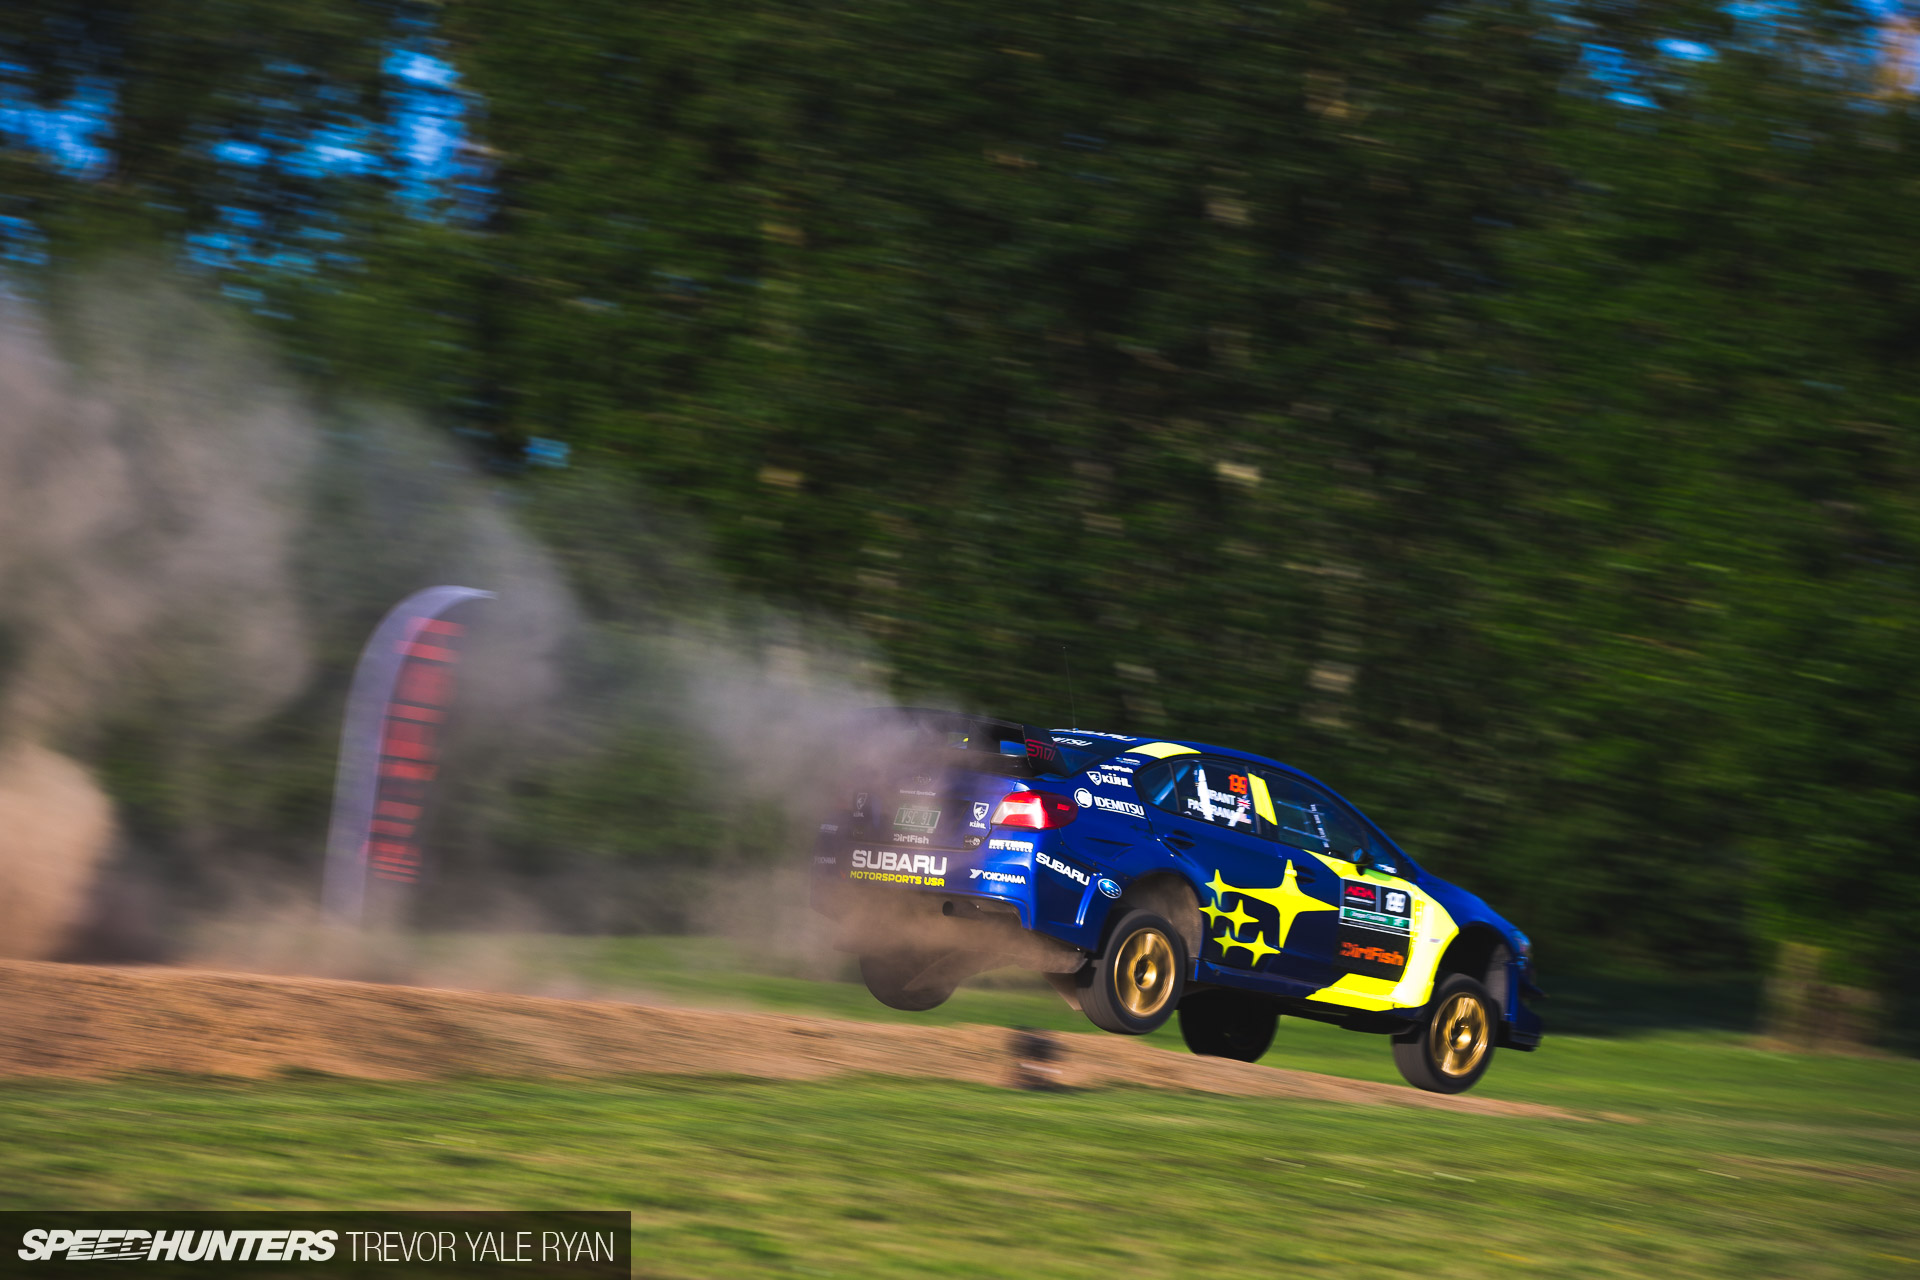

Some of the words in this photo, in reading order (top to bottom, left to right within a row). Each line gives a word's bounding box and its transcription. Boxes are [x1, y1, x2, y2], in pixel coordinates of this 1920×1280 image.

[1093, 796, 1145, 816] IDEMITSU
[893, 833, 930, 845] DirtFish
[851, 849, 948, 876] SUBARU
[1035, 851, 1091, 887] SUBARU
[850, 870, 922, 885] MOTORSPORTS
[923, 876, 945, 887] USA
[982, 871, 1026, 885] YOKOHAMA
